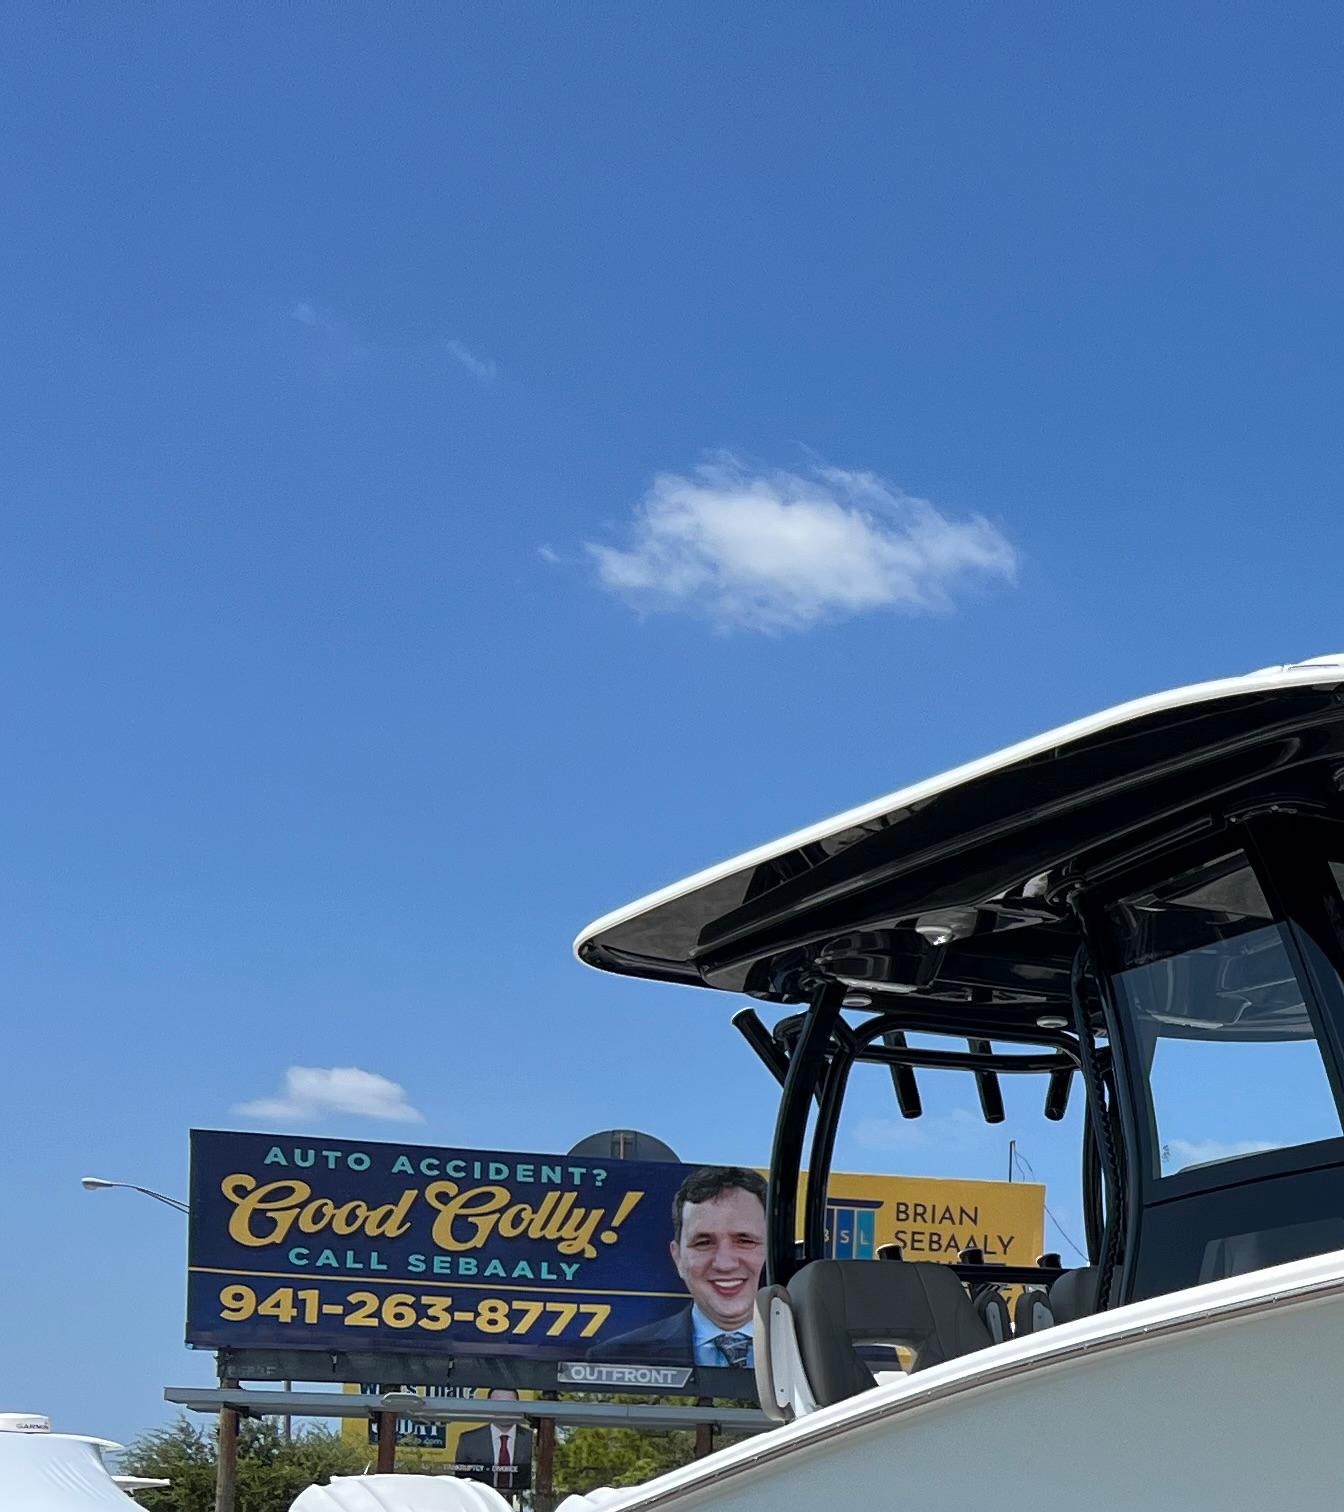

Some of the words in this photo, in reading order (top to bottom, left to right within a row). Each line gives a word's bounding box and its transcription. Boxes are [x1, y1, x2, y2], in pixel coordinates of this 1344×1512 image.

[263, 1146, 372, 1171] AUTO
[391, 1155, 608, 1187] ACCIDENT?
[220, 1173, 419, 1247] Good
[424, 1181, 646, 1259] Golly!
[896, 1202, 979, 1226] BRIAN
[894, 1230, 1015, 1255] SEBAALY
[287, 1247, 388, 1270] CALL
[407, 1254, 582, 1281] SEBAALY
[218, 1284, 611, 1338] 941-263-8777
[570, 1365, 678, 1384] OUTFRONT
